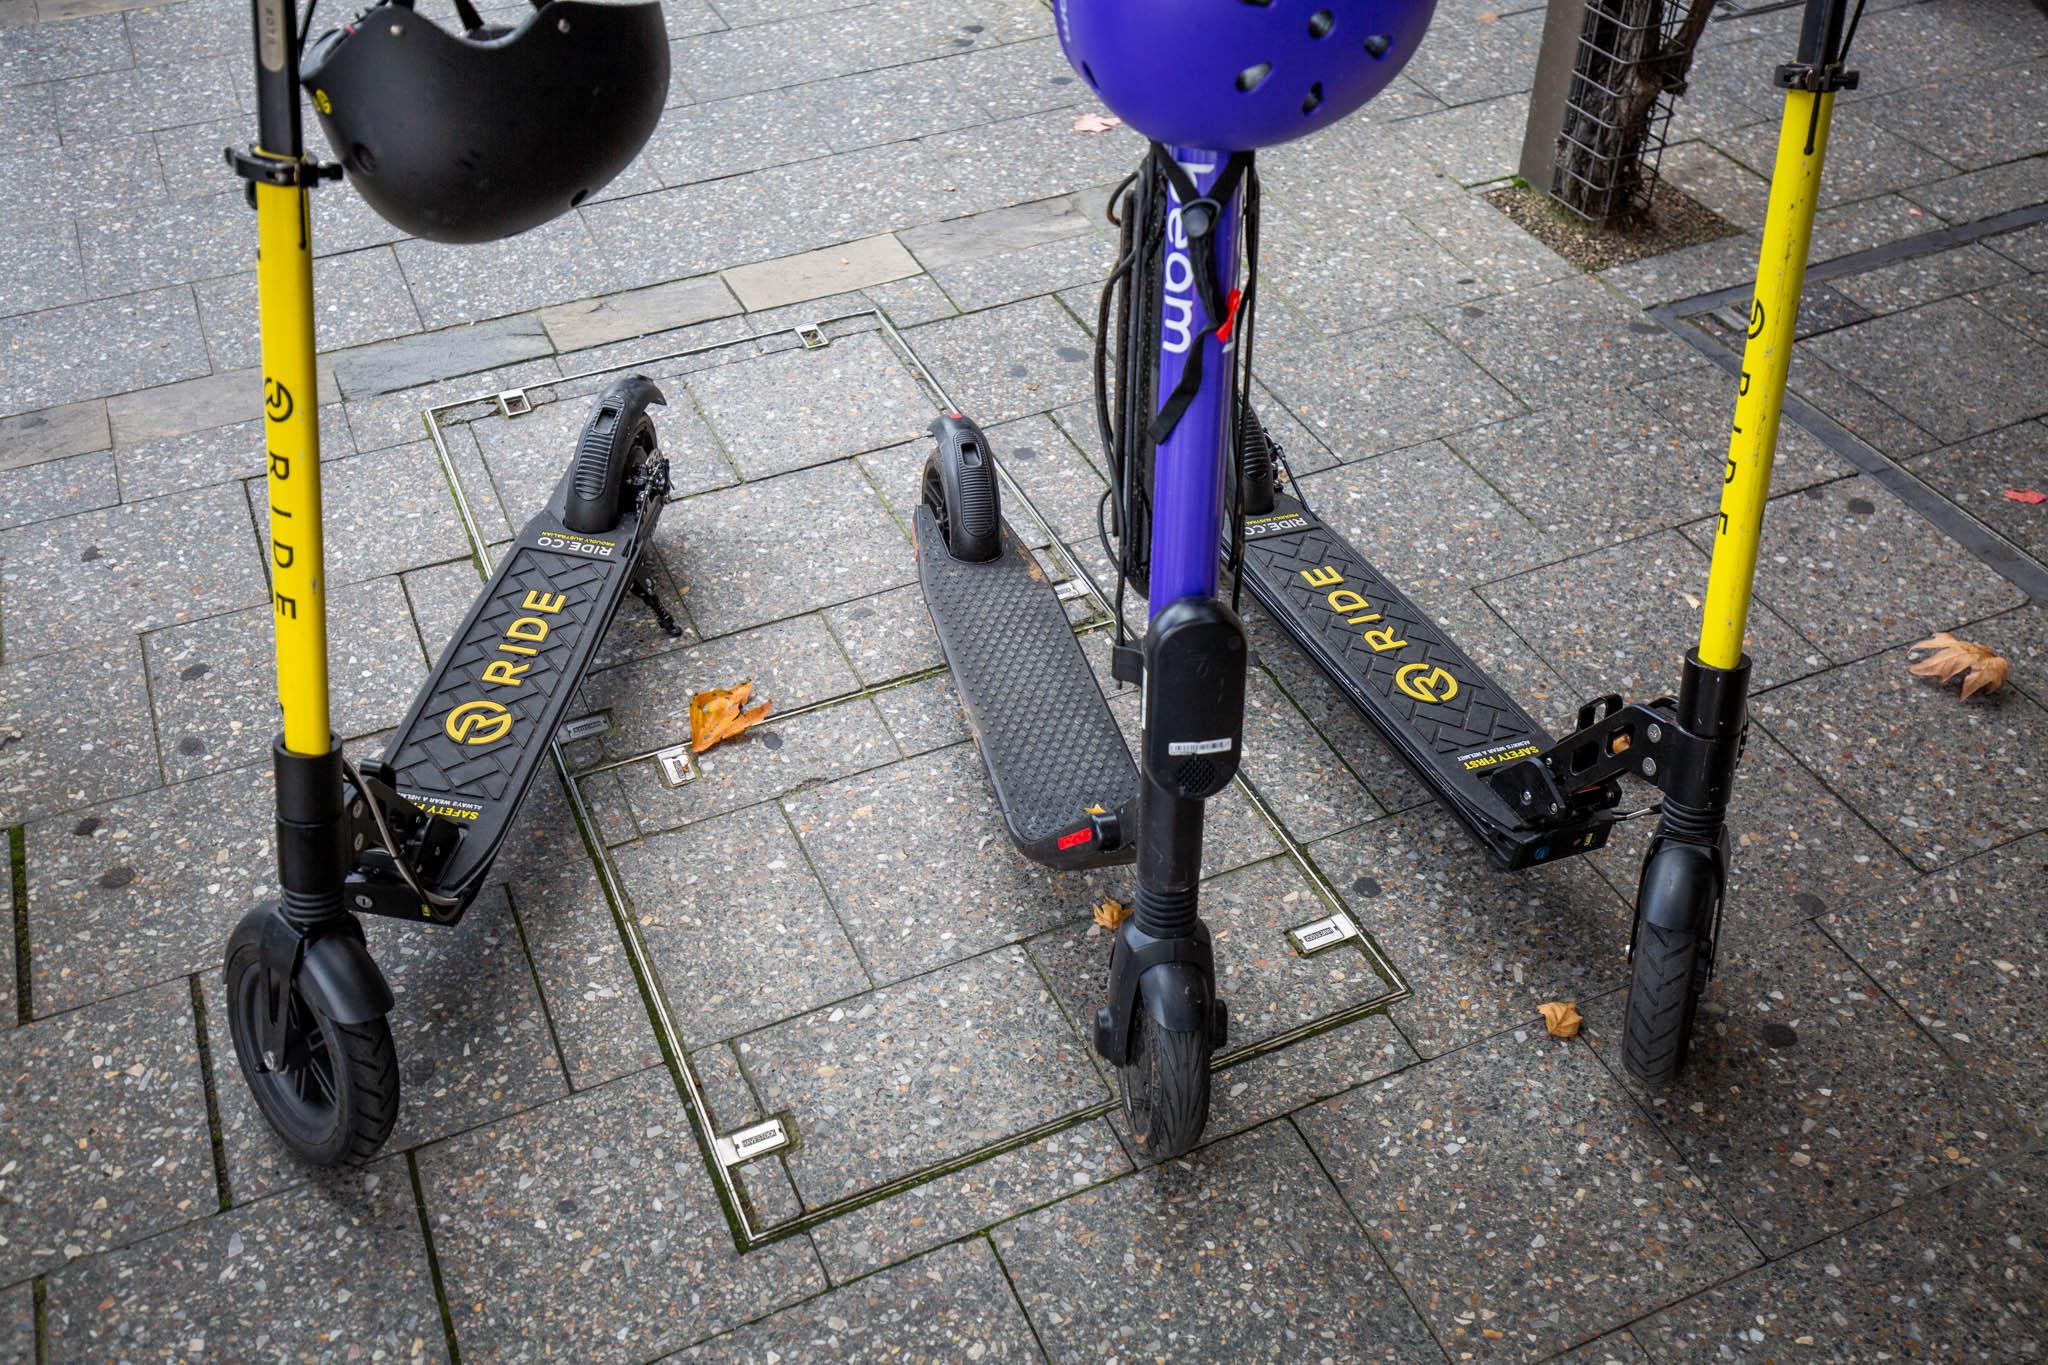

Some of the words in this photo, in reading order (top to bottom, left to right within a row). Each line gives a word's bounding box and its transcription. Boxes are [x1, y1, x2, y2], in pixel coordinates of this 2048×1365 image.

[269, 451, 297, 620] RIDE
[537, 536, 613, 556] RIDE.CO
[1300, 565, 1408, 652] RIDE
[481, 589, 568, 688] RIDE
[1497, 745, 1540, 762] SAFETY
[1463, 756, 1496, 770] FIRST
[427, 804, 480, 820] SAFETY
[452, 801, 482, 810] ALWAYS
